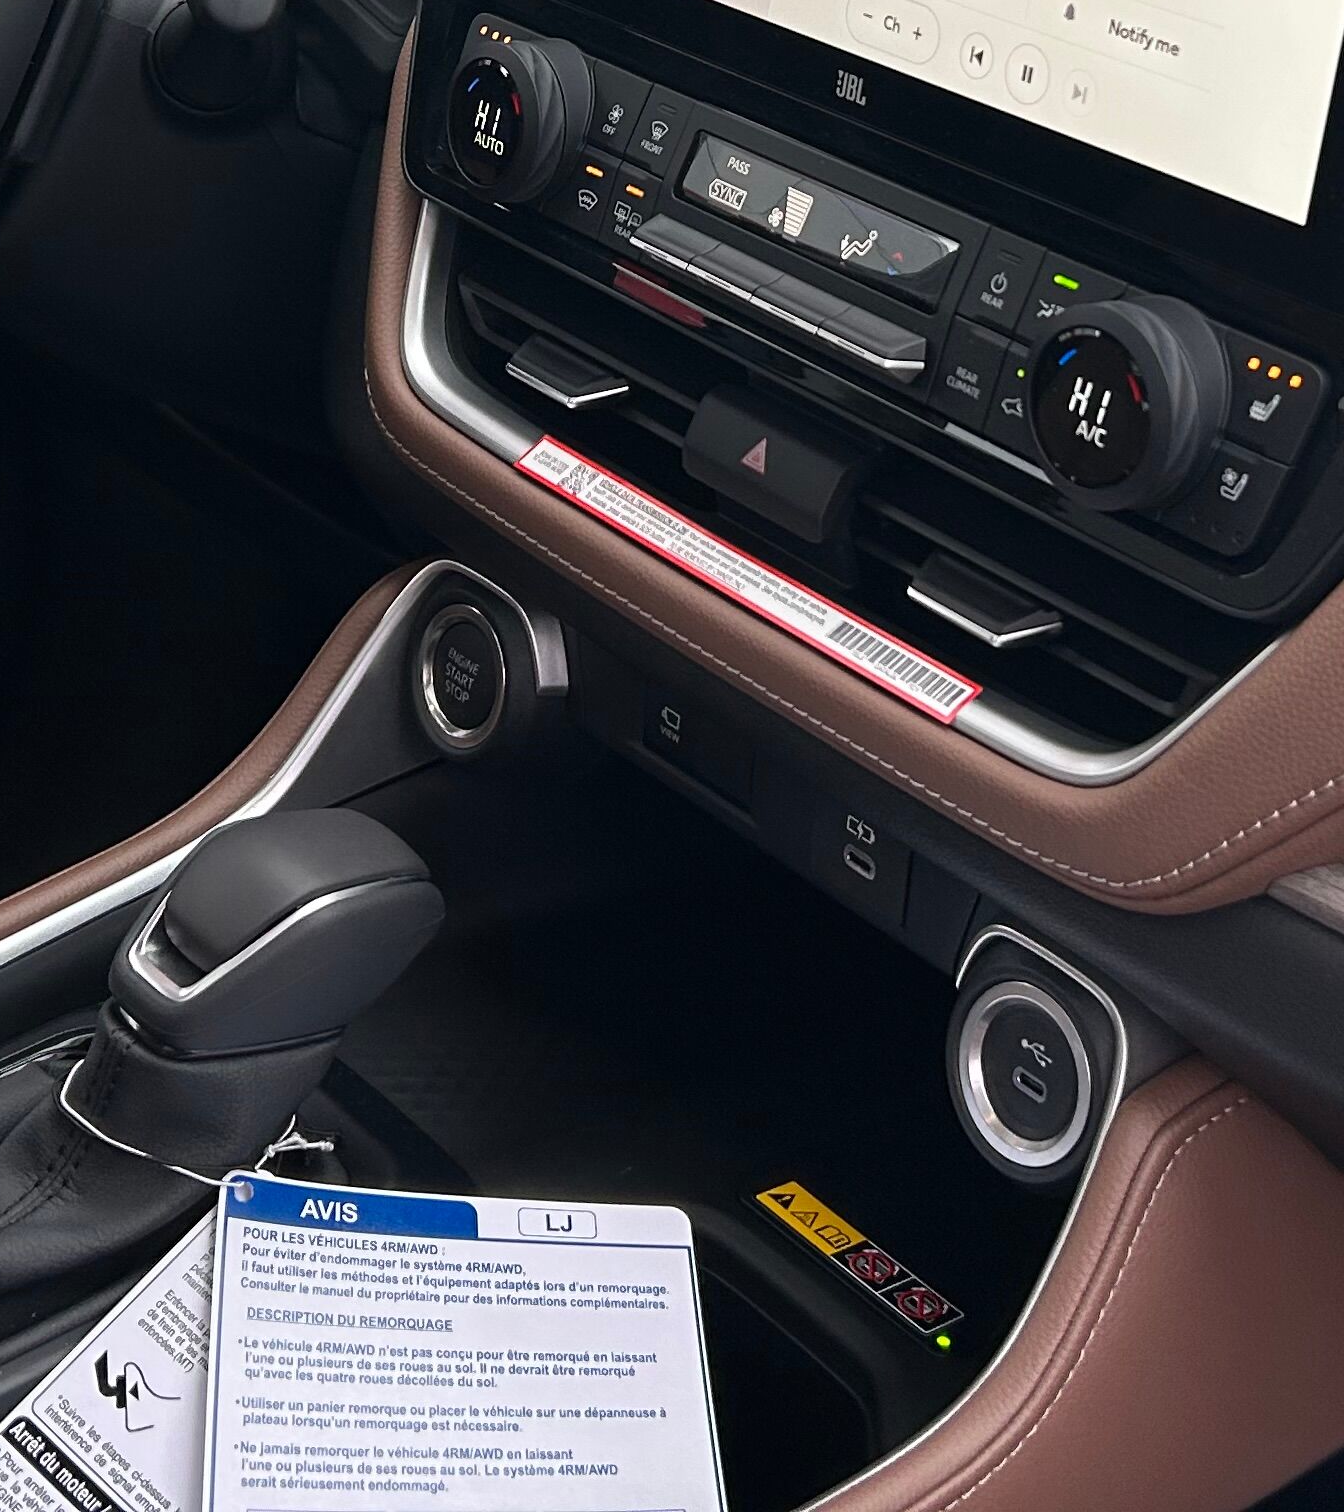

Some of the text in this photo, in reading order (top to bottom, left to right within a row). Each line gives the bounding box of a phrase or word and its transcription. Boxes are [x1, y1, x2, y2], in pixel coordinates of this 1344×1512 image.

[882, 15, 901, 33] Ch
[1107, 18, 1181, 57] Notify me
[836, 69, 867, 107] JBL
[474, 99, 502, 136] HI
[473, 131, 505, 156] AUTO
[727, 156, 751, 175] PASS
[712, 183, 743, 206] SYNC
[980, 291, 1004, 311] REAR
[1068, 376, 1112, 426] HI
[445, 662, 475, 689] START
[448, 646, 481, 677] ENGINE
[445, 679, 470, 703] STOP
[300, 1198, 359, 1223] AVIS
[545, 1213, 573, 1232] LJ
[243, 1226, 438, 1255] POUR LES VÉHICULES 4RM/AWD
[242, 1243, 527, 1276] Pour éviter d'endommager le système 4RM/AWD,
[251, 1261, 275, 1275] faut
[277, 1263, 318, 1279] utiliser
[320, 1268, 338, 1280] les
[340, 1270, 398, 1285] méthodes
[401, 1274, 413, 1285] et
[415, 1275, 492, 1291] l'équipement
[494, 1279, 540, 1294] adaptés
[543, 1281, 566, 1292] lors
[568, 1282, 594, 1293] d'un
[597, 1283, 669, 1297] remorquage.
[163, 1289, 199, 1323] Enfoncer
[240, 1277, 669, 1311] Consulter le manuel du propriétaire pour des informations complémentaires.
[247, 1307, 453, 1332] DESCRIPTION DU REMORQUAGE
[262, 1339, 312, 1353] véhicule
[315, 1342, 376, 1356] 4RM/AWD
[378, 1344, 408, 1357] n'est
[411, 1348, 433, 1360] pas
[436, 1349, 473, 1362] conçu
[476, 1350, 504, 1362] pour
[507, 1348, 530, 1361] être
[533, 1350, 590, 1364] remorqué
[593, 1352, 608, 1363] en
[611, 1351, 658, 1364] laissant
[241, 1396, 667, 1421] Utiliser un panier remorque ou placer le véhicule sur une dépanneuse à
[59, 1399, 172, 1510] Suivre les étapes ci-dessus
[240, 1440, 573, 1460] Ne jamais remorquer le véhicule 4RM/AWD en laissant
[0, 1450, 55, 1506] Pour arrêter
[8, 1420, 104, 1512] Arrêt du moteur
[93, 1453, 107, 1468] de
[107, 1467, 137, 1494] signal
[241, 1476, 449, 1494] serait sérieusement endommagé.
